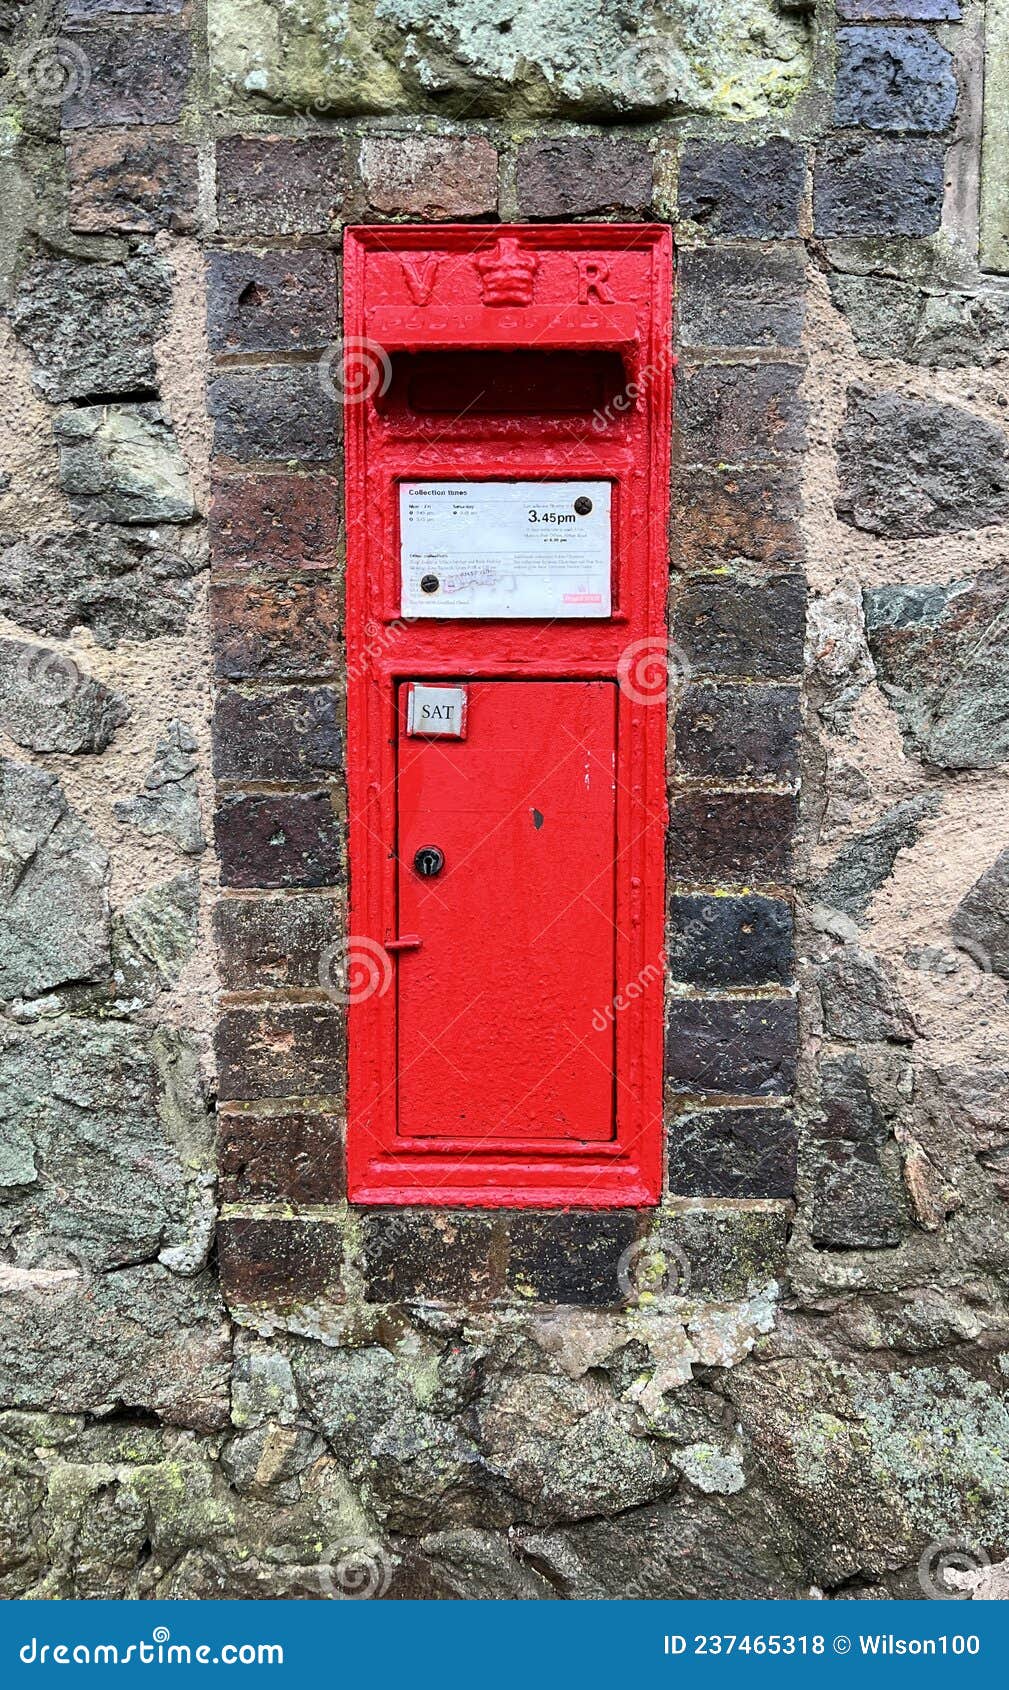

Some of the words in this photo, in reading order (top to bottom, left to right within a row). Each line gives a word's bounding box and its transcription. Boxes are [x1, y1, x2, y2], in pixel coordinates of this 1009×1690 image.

[401, 259, 438, 306] V
[577, 257, 616, 305] R
[528, 509, 576, 525] 3.45pm
[422, 704, 454, 719] SAT
